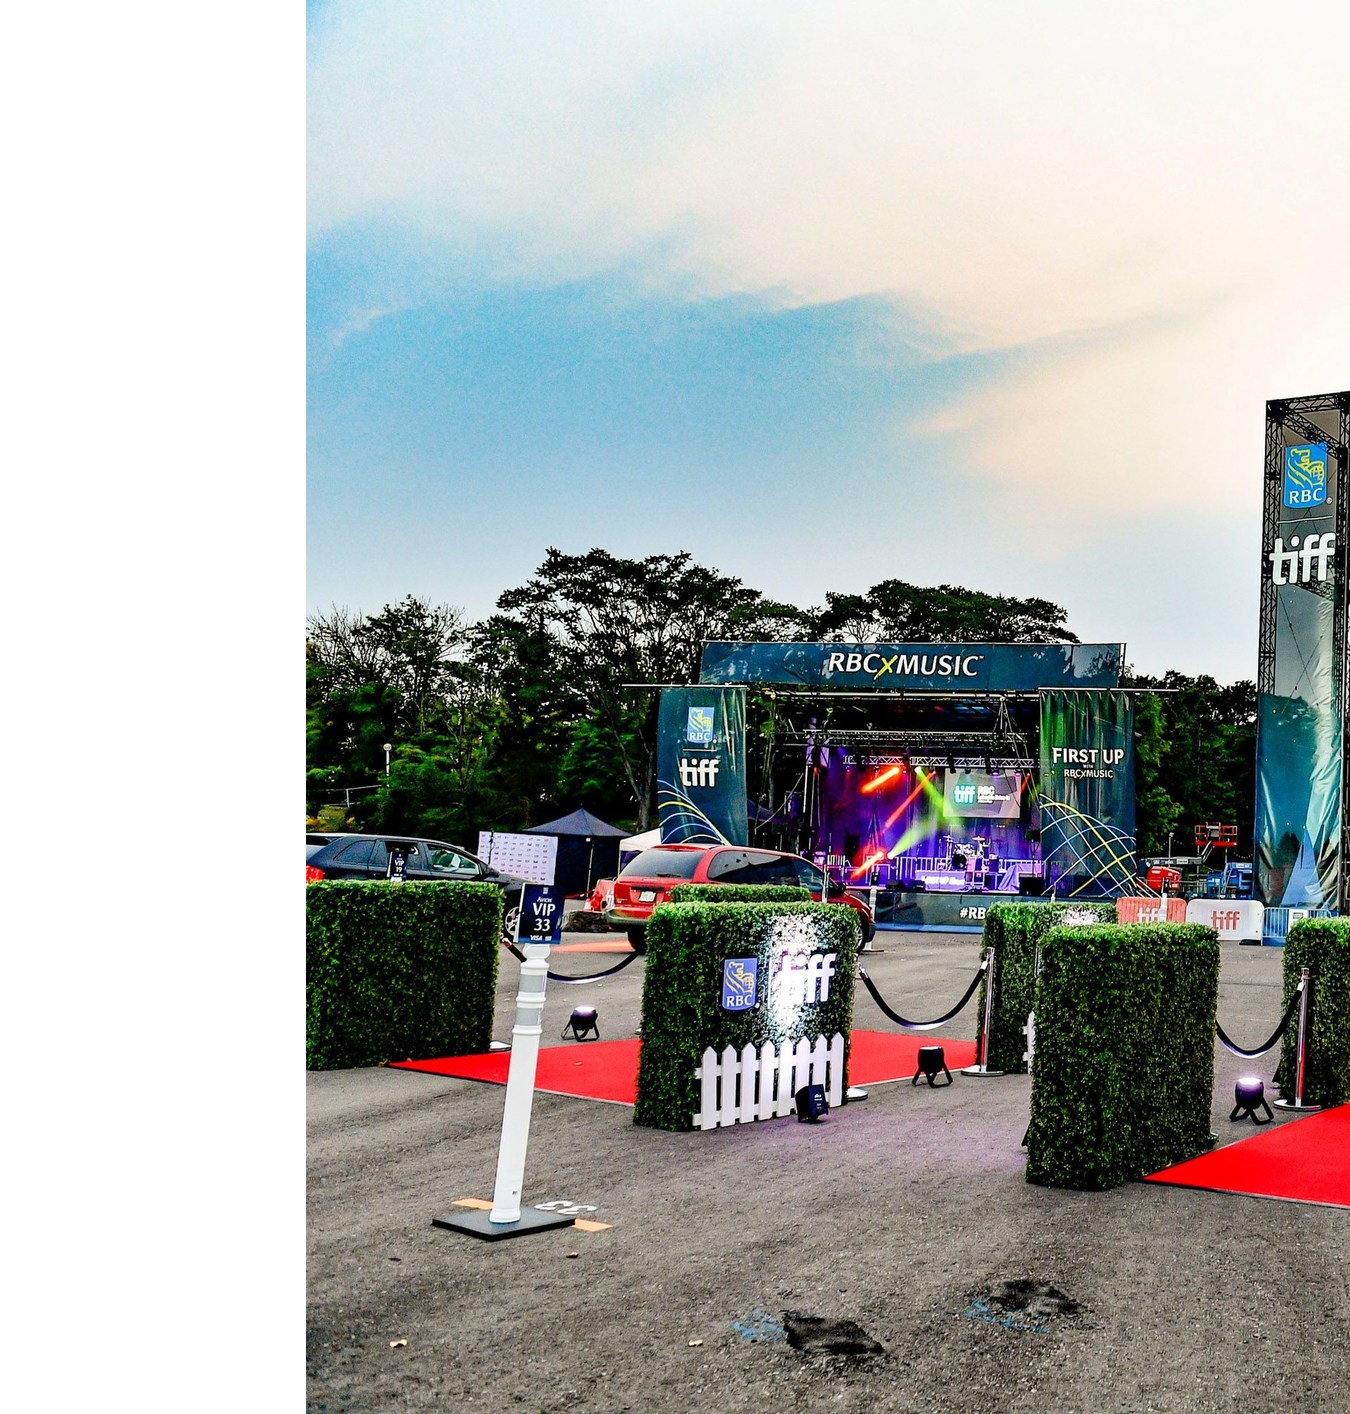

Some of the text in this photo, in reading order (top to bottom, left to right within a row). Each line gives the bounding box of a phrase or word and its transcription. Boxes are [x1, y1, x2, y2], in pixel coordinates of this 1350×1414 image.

[1289, 487, 1323, 504] RBC
[1269, 532, 1336, 586] tiff
[689, 732, 711, 741] RBC
[1052, 747, 1124, 765] FIRST UP
[679, 758, 719, 787] tiff
[954, 785, 975, 803] tiff
[533, 902, 556, 917] VIP
[960, 906, 987, 920] #RB
[533, 918, 551, 931] 33
[1211, 911, 1240, 930] tiff
[726, 994, 753, 1007] RBC
